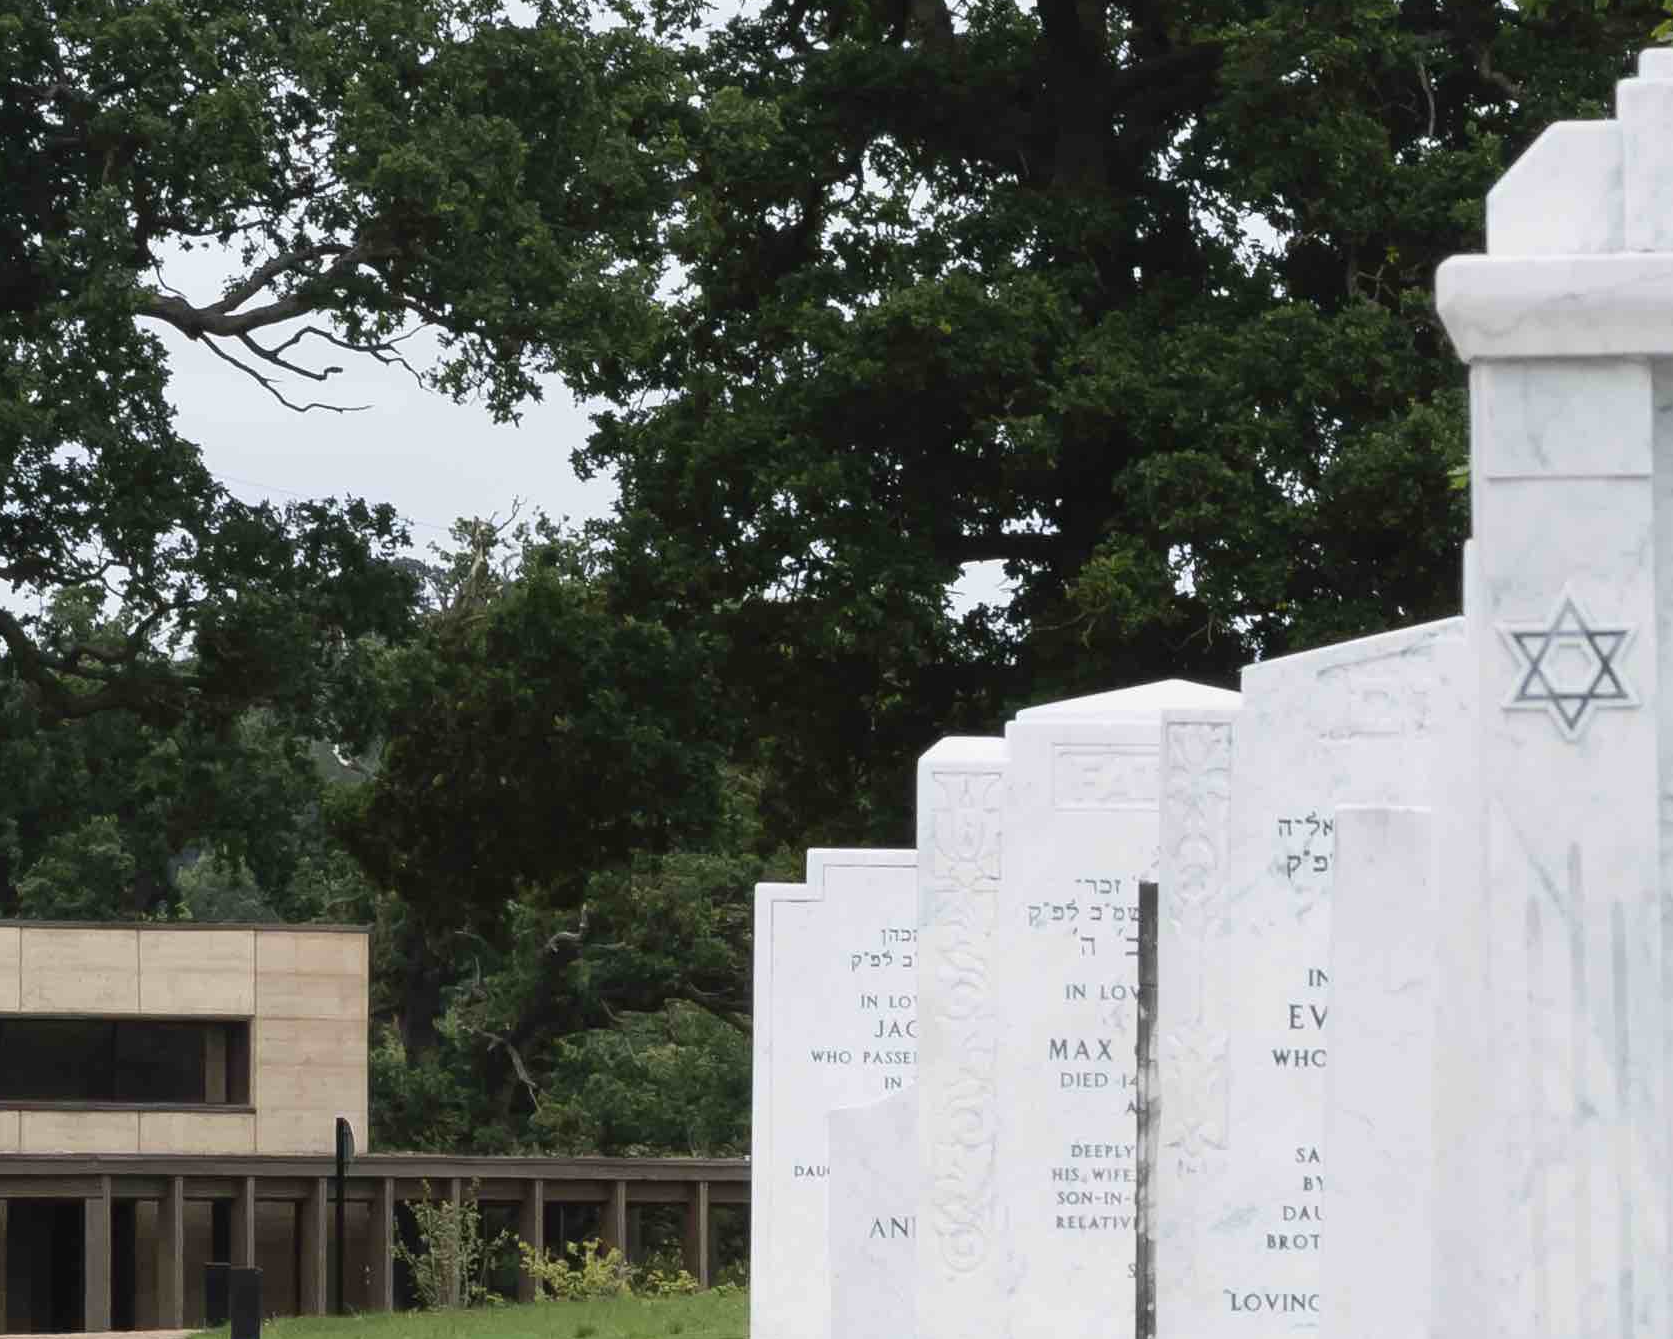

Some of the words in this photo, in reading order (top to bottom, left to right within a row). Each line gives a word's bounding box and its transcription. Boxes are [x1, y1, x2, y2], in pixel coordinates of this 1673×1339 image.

[1066, 984, 1086, 1000] IN
[860, 995, 878, 1008] IN
[1049, 1038, 1112, 1060] MAX
[811, 1050, 852, 1063] WHO
[884, 1076, 902, 1089] IN
[1060, 1072, 1108, 1088] DIED
[1071, 1145, 1135, 1158] DEEPLY
[1052, 1168, 1079, 1181] HIS
[1057, 1191, 1136, 1205] SON-IN-
[1056, 1216, 1136, 1229] RELATIV
